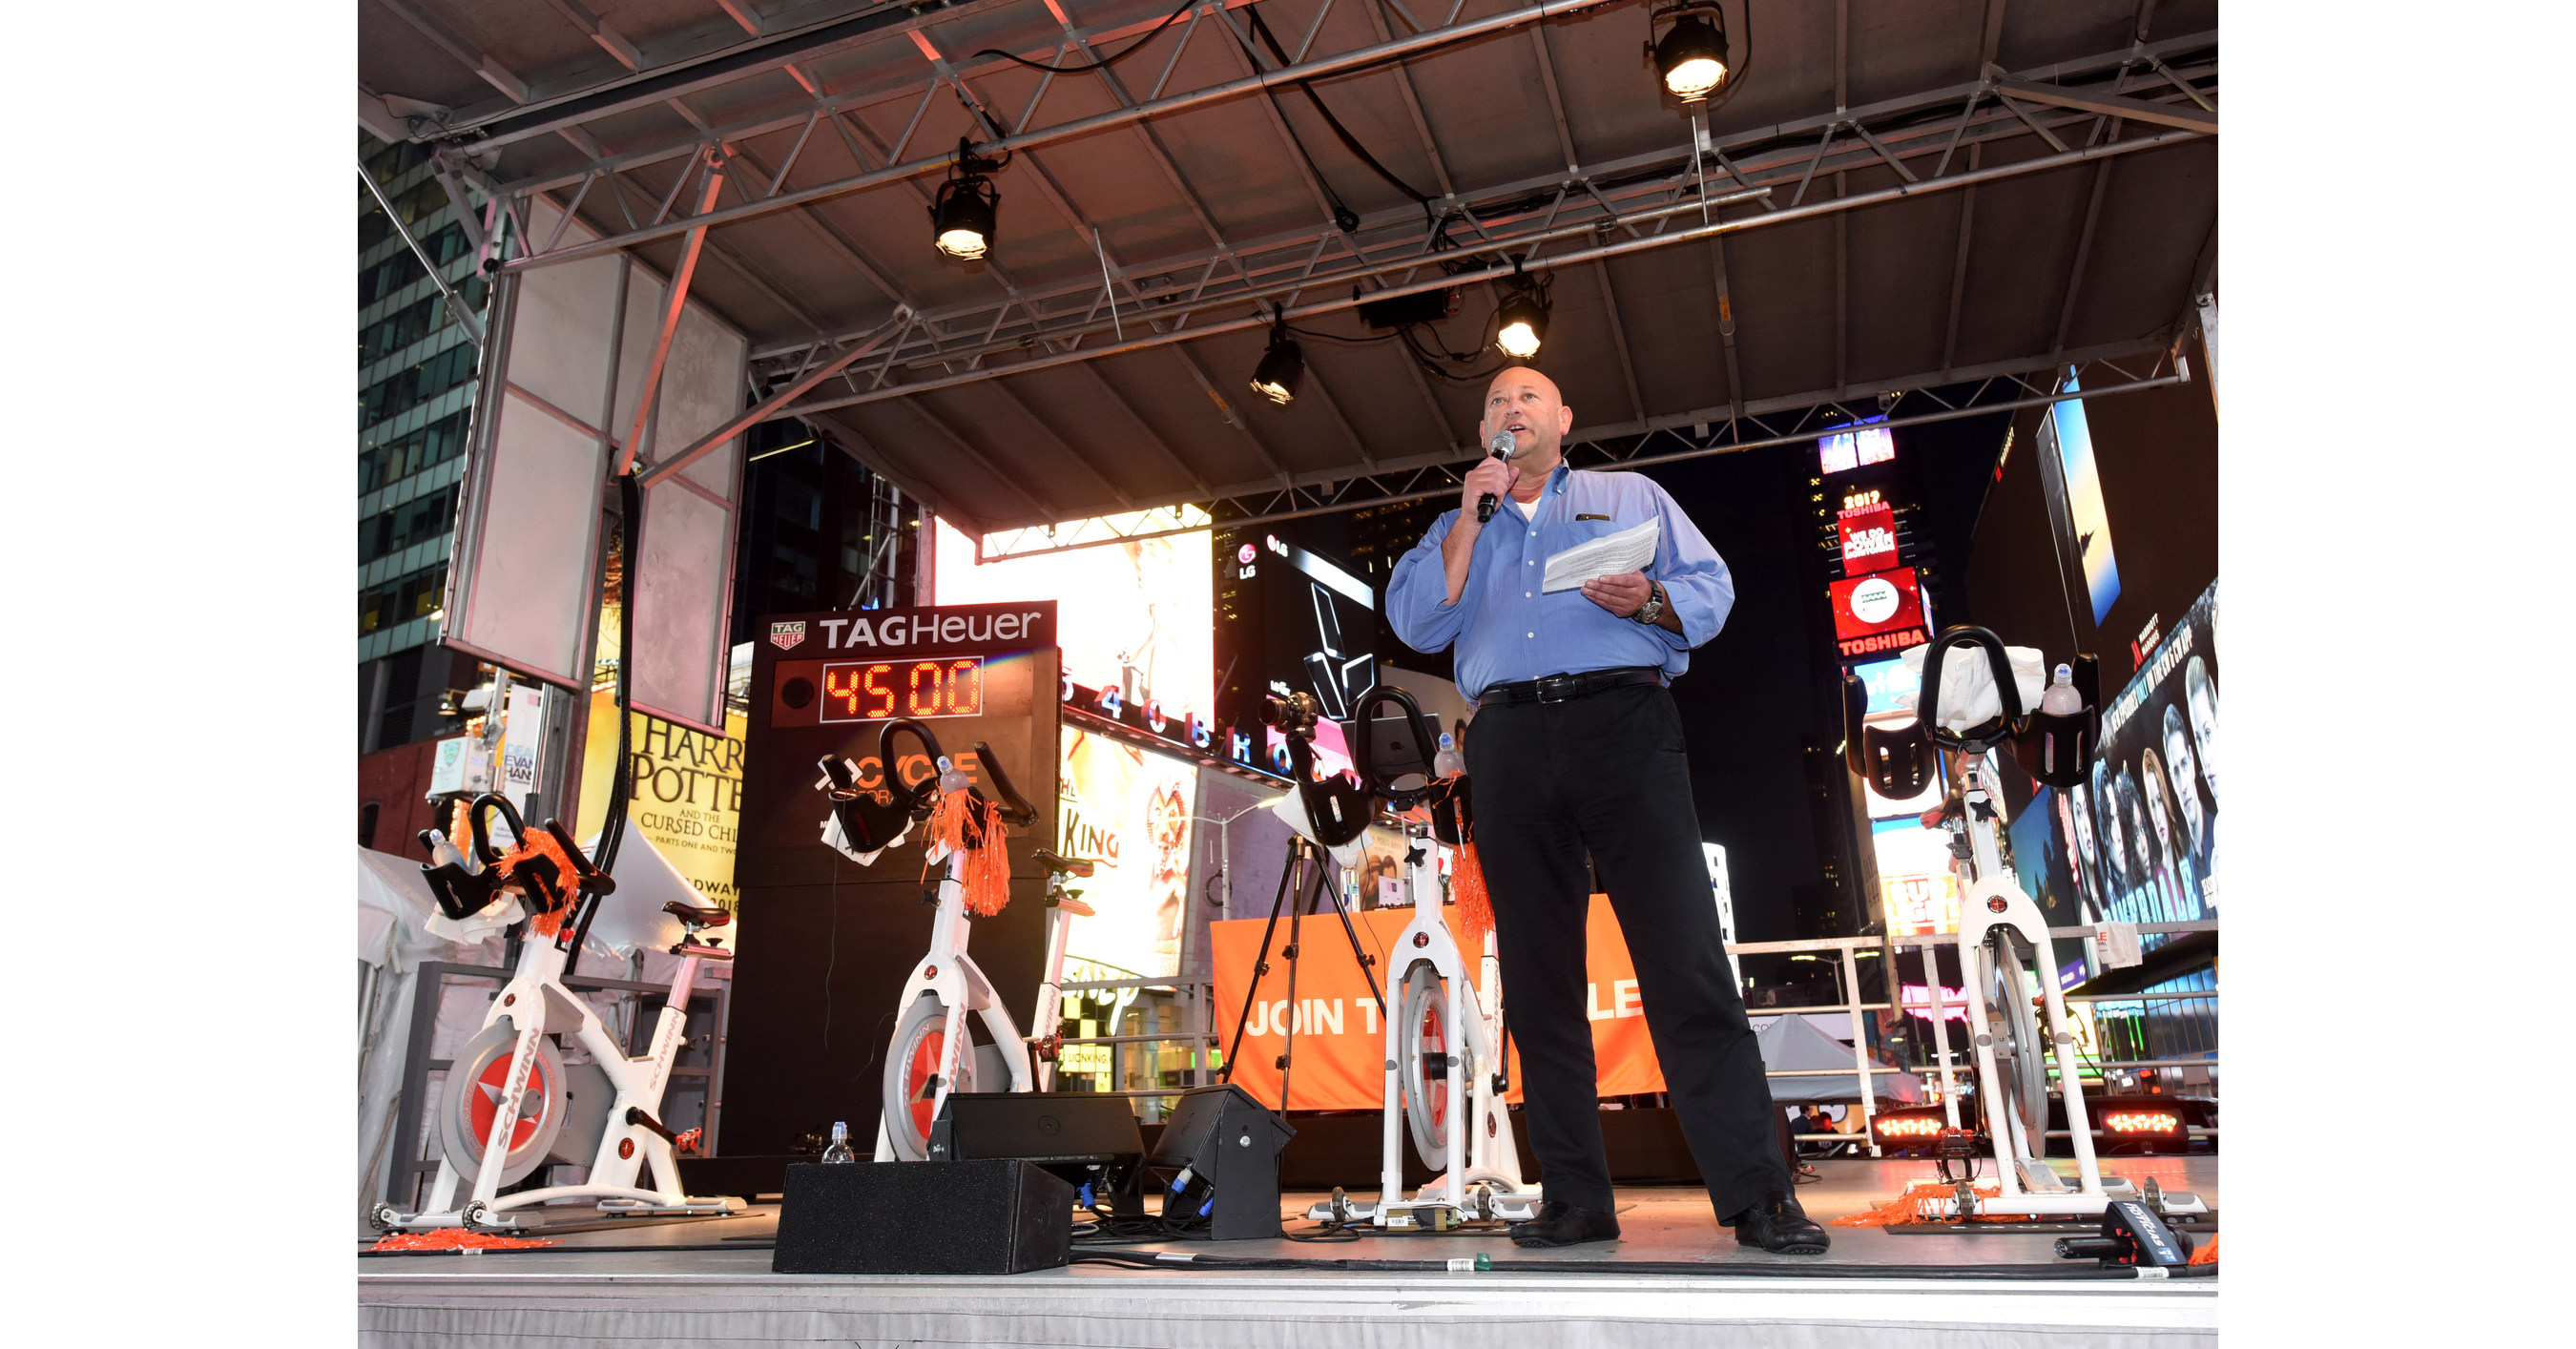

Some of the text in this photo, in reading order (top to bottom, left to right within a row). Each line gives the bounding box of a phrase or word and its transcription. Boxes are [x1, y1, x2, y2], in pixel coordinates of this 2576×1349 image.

[1843, 489, 1880, 509] 2017
[1837, 501, 1891, 520] TOSHIBA
[1276, 540, 1289, 558] LG
[1238, 565, 1257, 580] LG
[774, 623, 803, 633] TAG
[771, 633, 804, 648] HEUER
[1839, 629, 1926, 657] TOSHIBA
[641, 716, 745, 773] HARR
[641, 812, 703, 837] CURSED
[679, 809, 720, 823] AND THE
[655, 836, 679, 847] PARTS
[681, 839, 698, 850] ONE
[700, 843, 718, 853] AND
[1063, 808, 1119, 859] KING
[1245, 998, 1344, 1037] JOIN
[650, 1010, 679, 1091] SCHWINN
[904, 1023, 930, 1108] SCHWINN
[498, 1027, 540, 1150] SCHWINN
